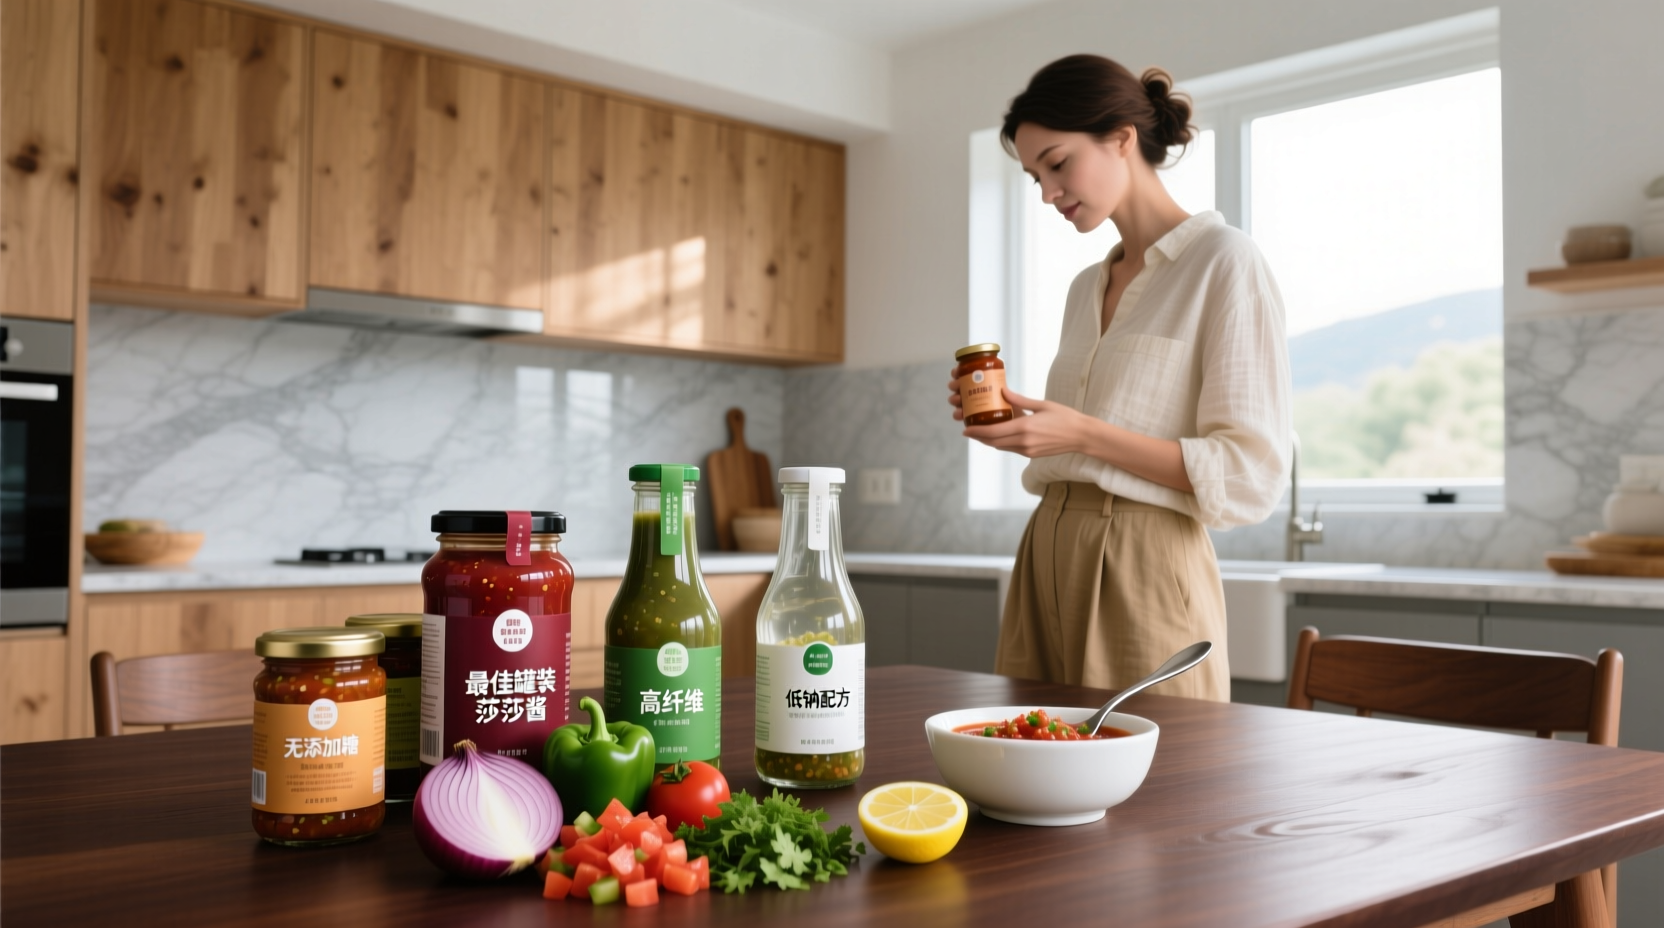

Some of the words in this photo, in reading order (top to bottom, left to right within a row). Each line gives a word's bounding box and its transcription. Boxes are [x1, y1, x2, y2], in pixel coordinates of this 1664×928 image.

[465, 667, 556, 696] 最佳罐装
[475, 696, 547, 724] 莎莎酱
[639, 688, 705, 715] 高纤维
[785, 687, 851, 709] 低钠配方
[284, 733, 359, 759] 无添加糖
